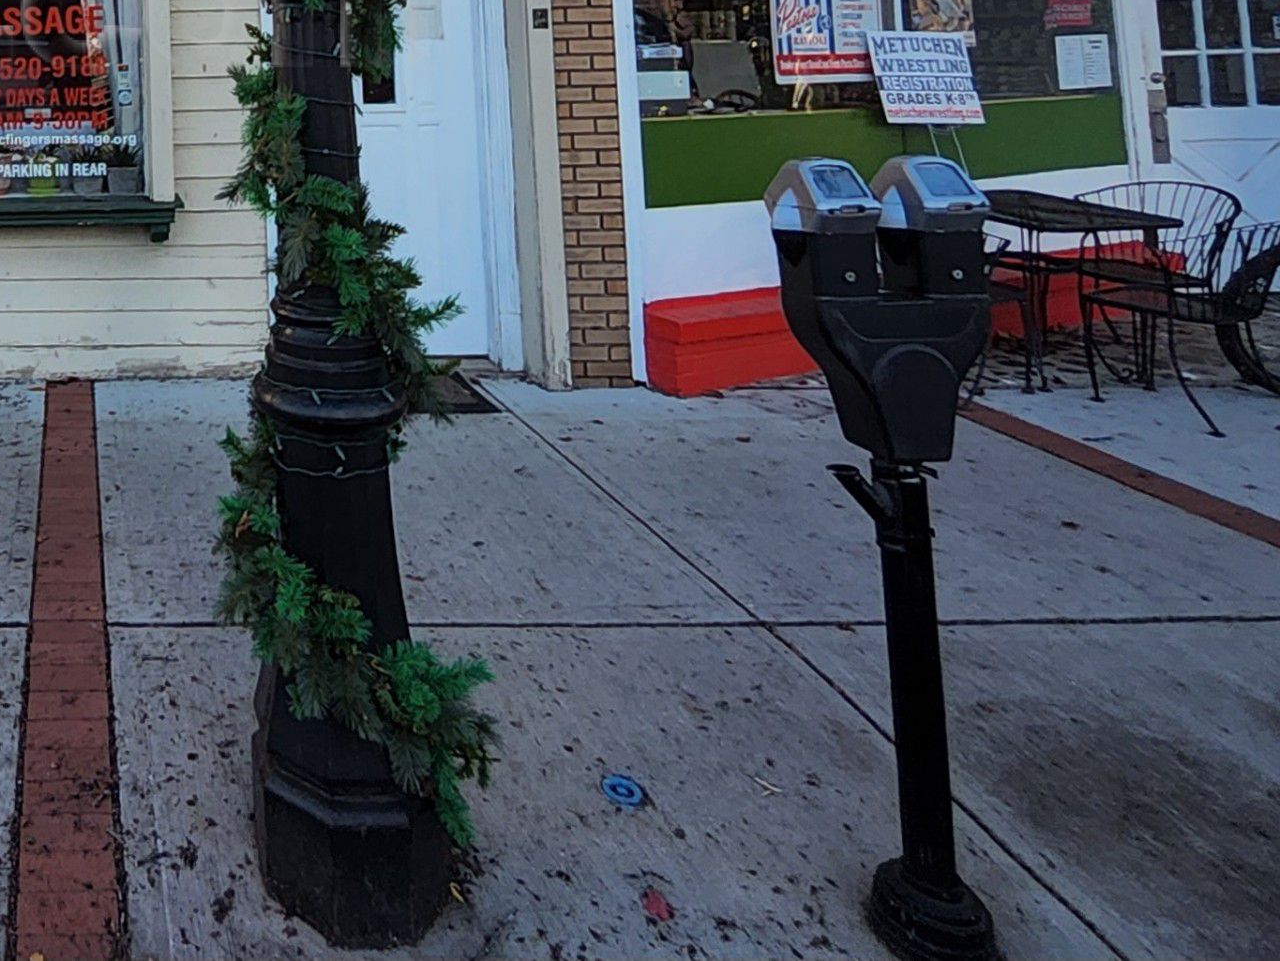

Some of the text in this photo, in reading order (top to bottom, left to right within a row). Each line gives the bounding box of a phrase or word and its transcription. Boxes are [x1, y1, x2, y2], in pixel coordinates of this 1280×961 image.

[871, 36, 965, 58] METUCHEN
[877, 58, 969, 74] WRESTLING
[883, 76, 974, 91] REGISTRATION
[6, 88, 45, 107] DAYS
[50, 88, 61, 106] A
[65, 87, 109, 106] WEEK
[886, 93, 942, 105] GRADES
[56, 163, 69, 177] IN
[72, 162, 108, 177] REAR
